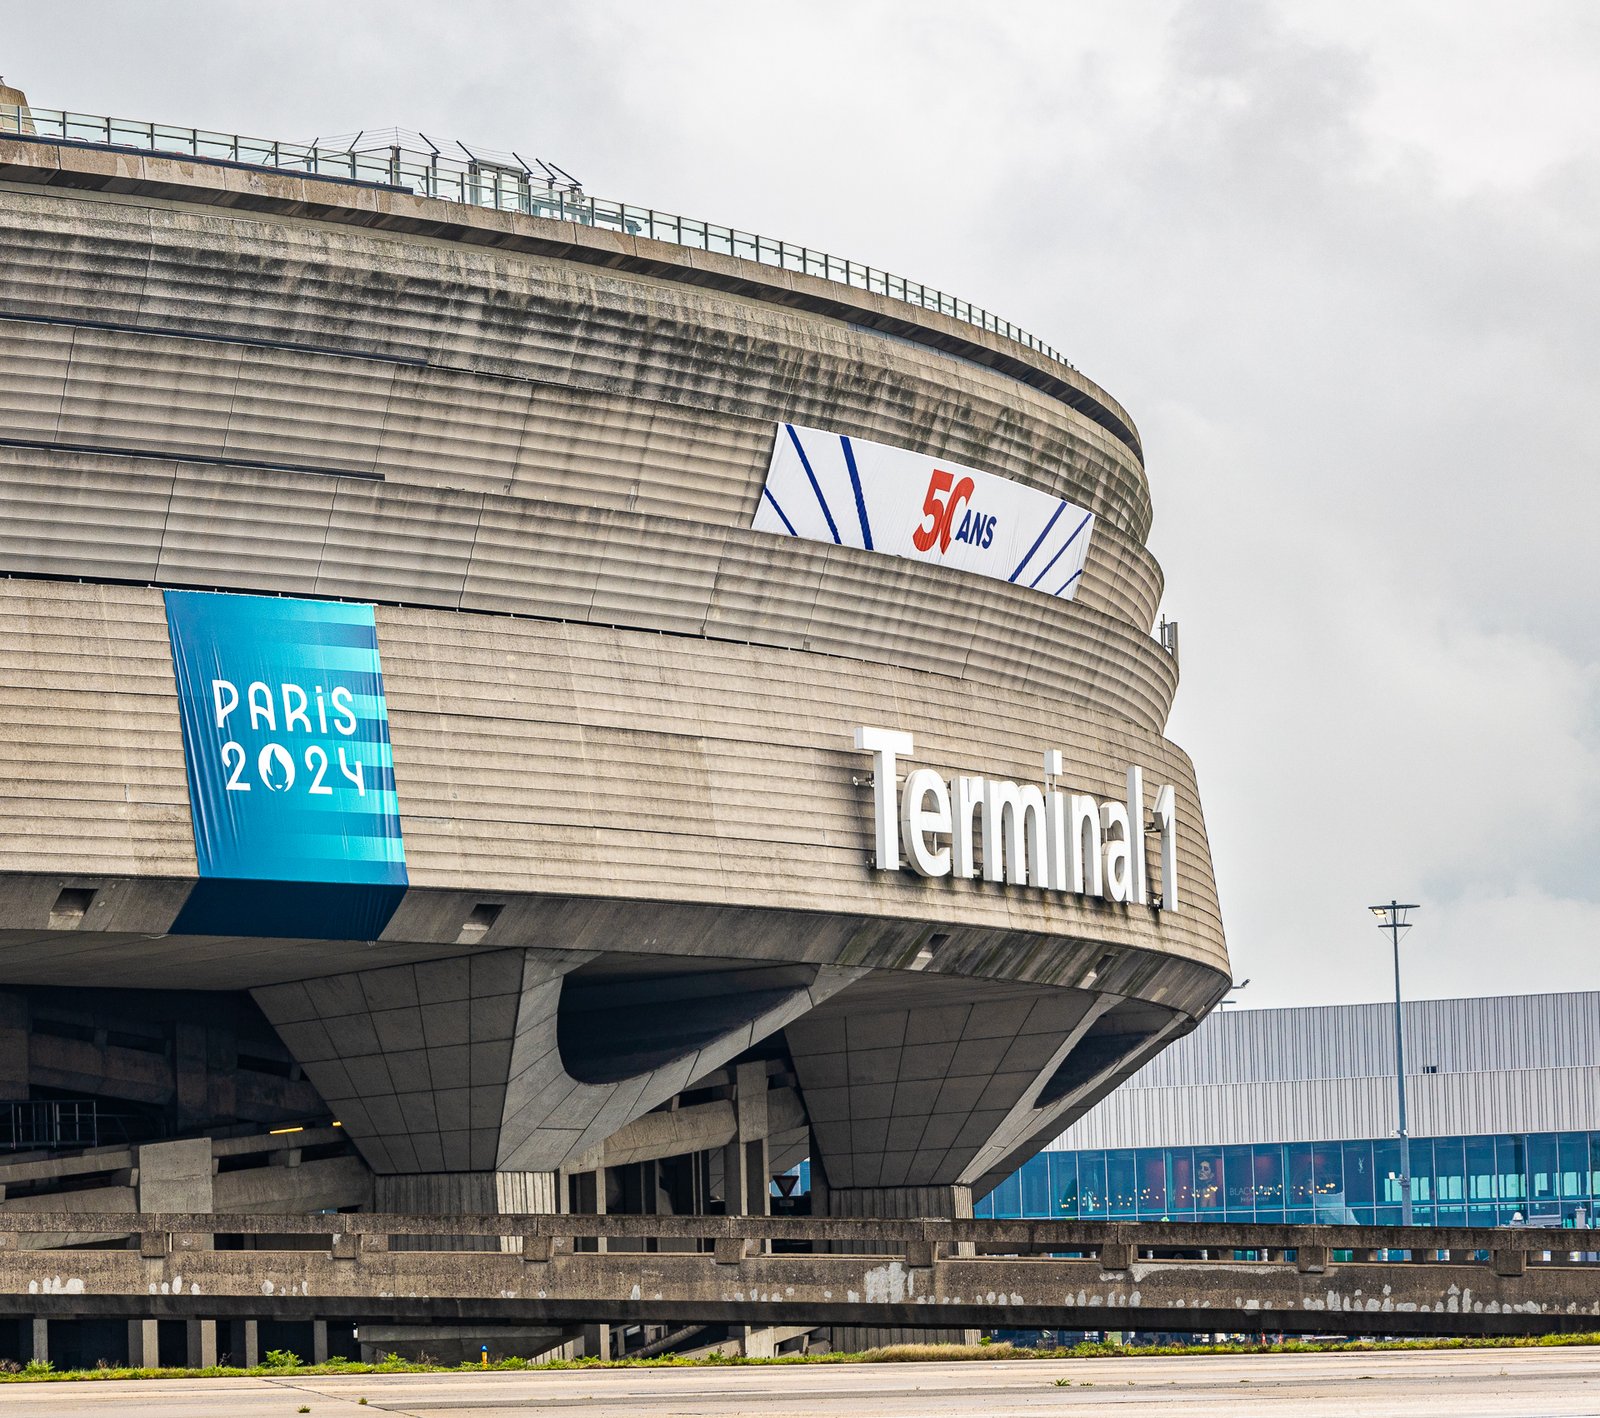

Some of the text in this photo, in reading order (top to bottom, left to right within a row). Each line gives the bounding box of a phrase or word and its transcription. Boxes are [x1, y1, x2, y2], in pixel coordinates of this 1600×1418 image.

[913, 468, 998, 555] 50 ANS
[221, 741, 366, 797] 2024
[854, 726, 1179, 912] Terminal 1
